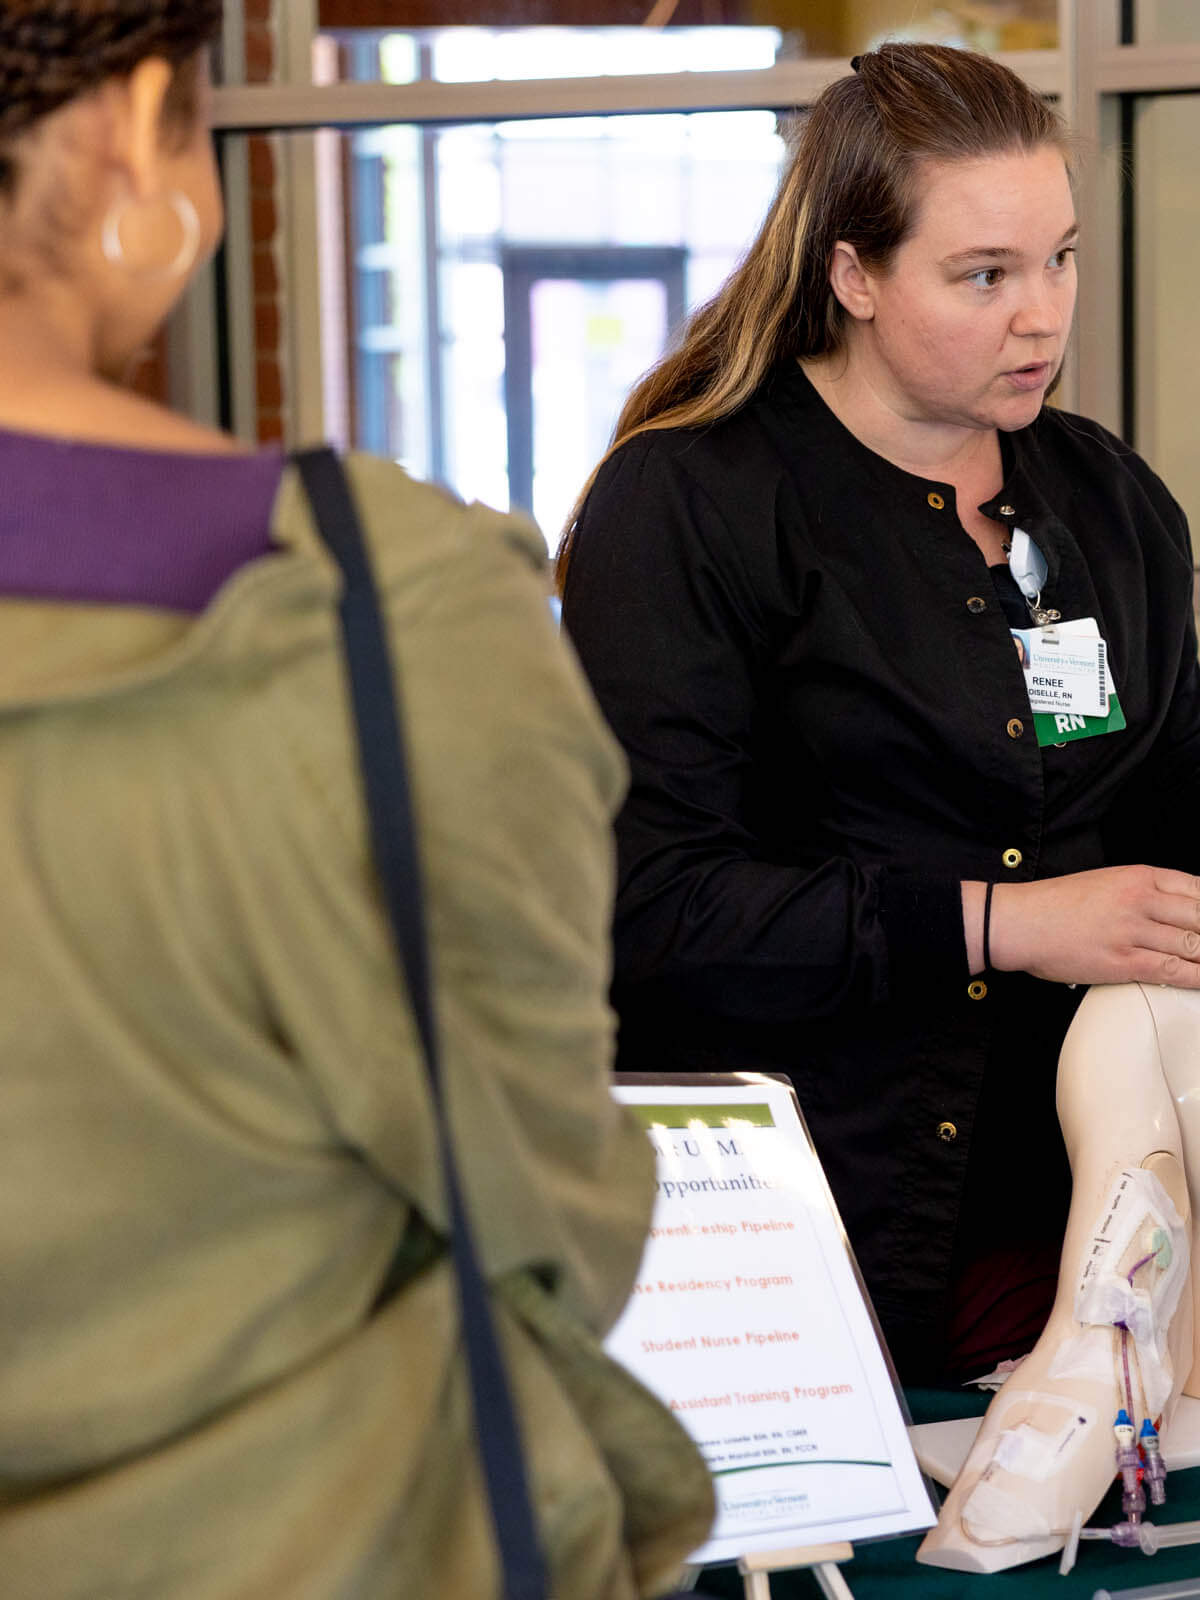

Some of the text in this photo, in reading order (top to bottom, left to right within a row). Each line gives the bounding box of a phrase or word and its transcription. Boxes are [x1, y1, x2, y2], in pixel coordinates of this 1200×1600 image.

[1032, 676, 1064, 688] RENEE
[1054, 713, 1086, 734] RN
[741, 1217, 795, 1235] Pipeline
[735, 1273, 794, 1289] Program
[641, 1328, 800, 1353] Student Nurse Pipeline
[734, 1389, 791, 1404] Training
[793, 1383, 854, 1400] Program
